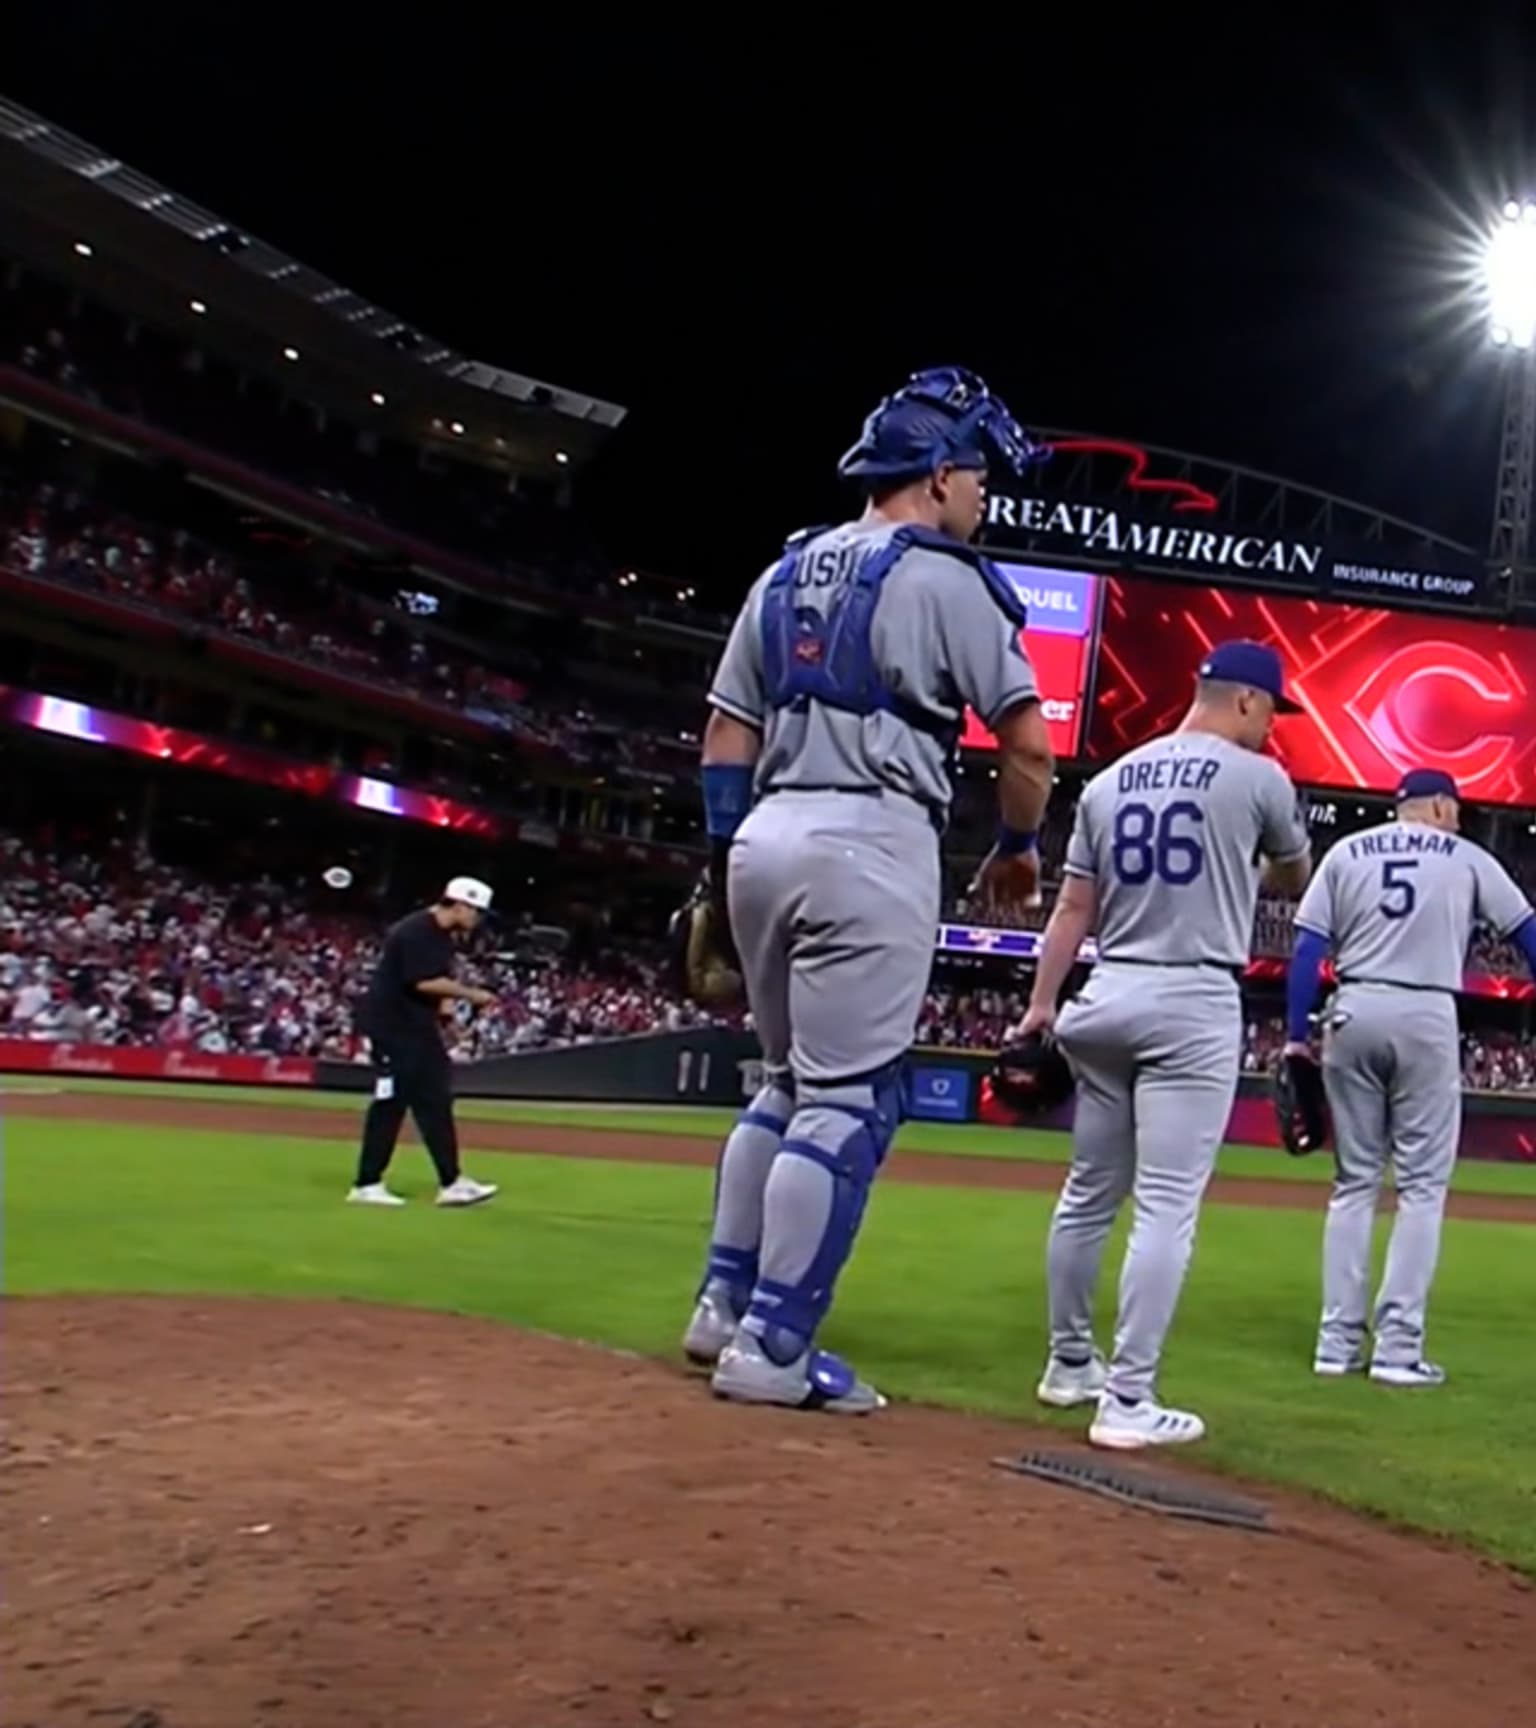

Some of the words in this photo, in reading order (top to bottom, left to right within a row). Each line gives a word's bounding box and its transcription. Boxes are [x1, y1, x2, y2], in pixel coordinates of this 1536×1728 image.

[1333, 564, 1419, 589] INSURANCE
[1423, 574, 1474, 595] GROUP
[1118, 757, 1221, 795] DREYER
[1112, 800, 1204, 886] 86
[1349, 832, 1459, 861] FREEMAN
[1380, 859, 1420, 919] 5
